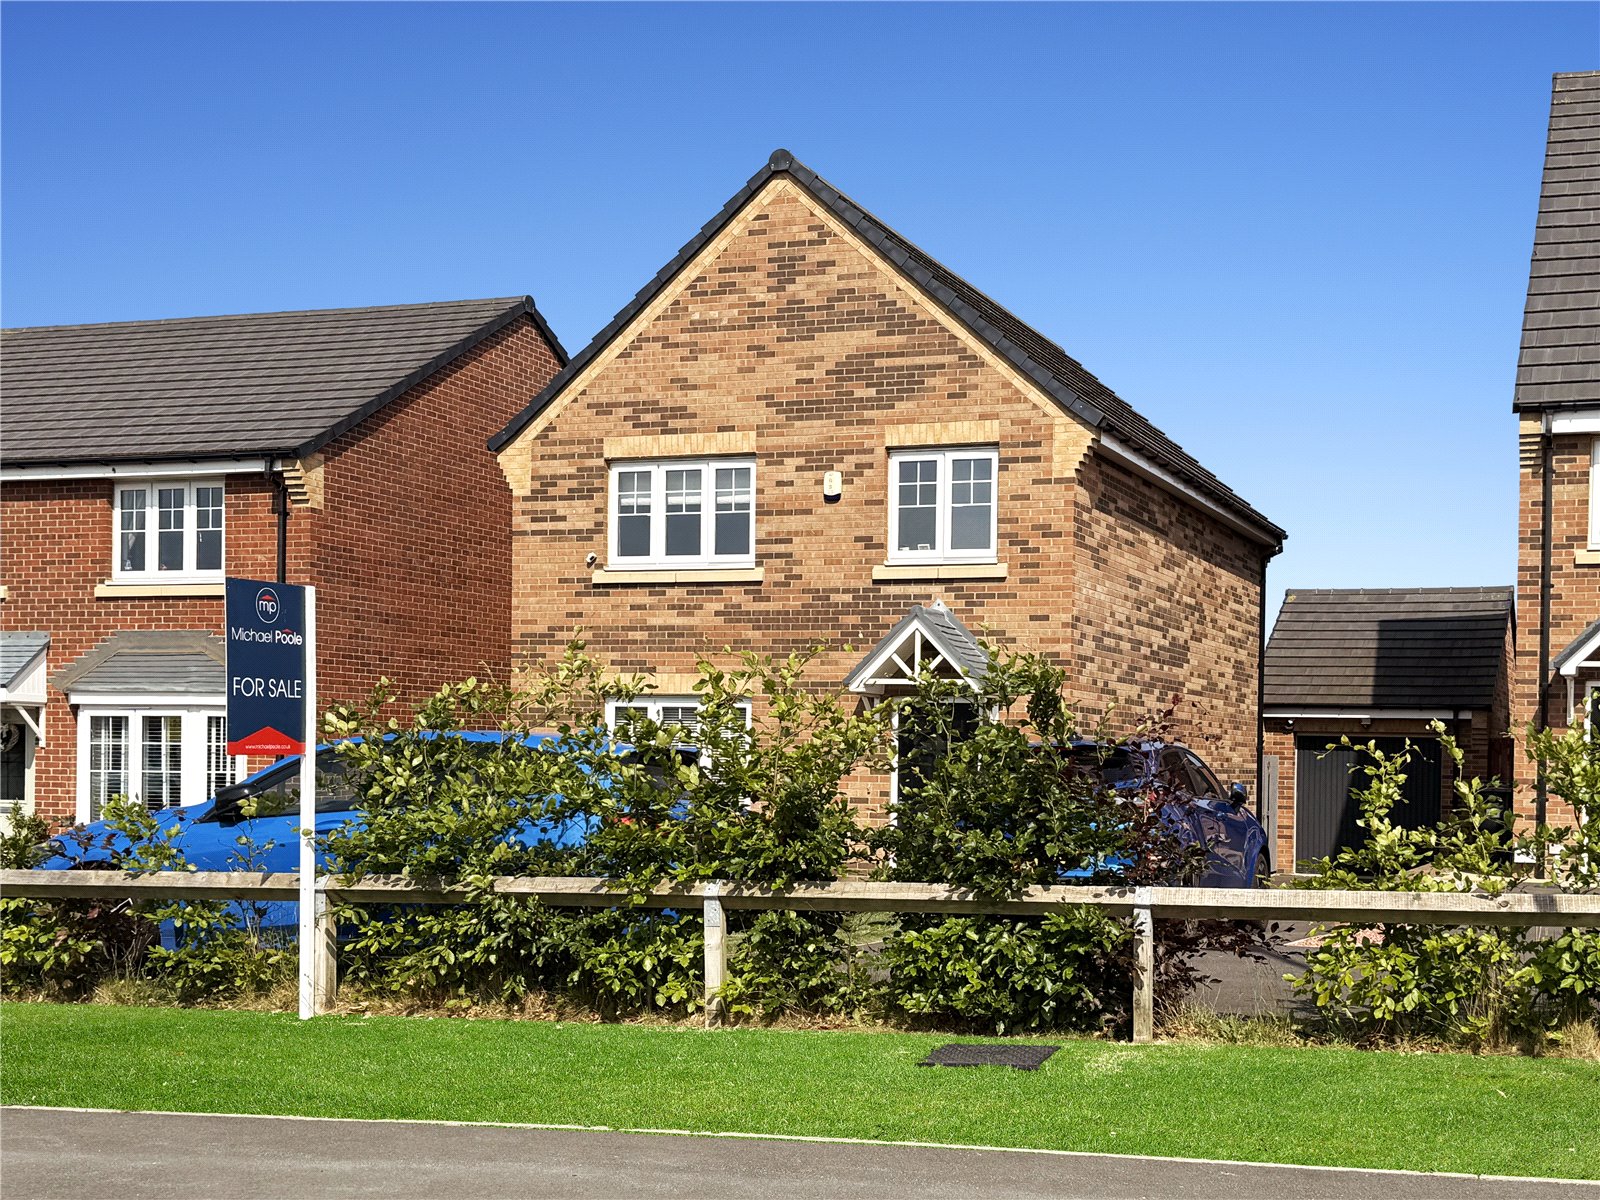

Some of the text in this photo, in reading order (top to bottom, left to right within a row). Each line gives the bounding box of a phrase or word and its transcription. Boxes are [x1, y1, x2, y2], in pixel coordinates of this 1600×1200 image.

[258, 600, 277, 613] mp
[231, 627, 303, 646] Michael Poole
[233, 677, 302, 698] FOR SALE
